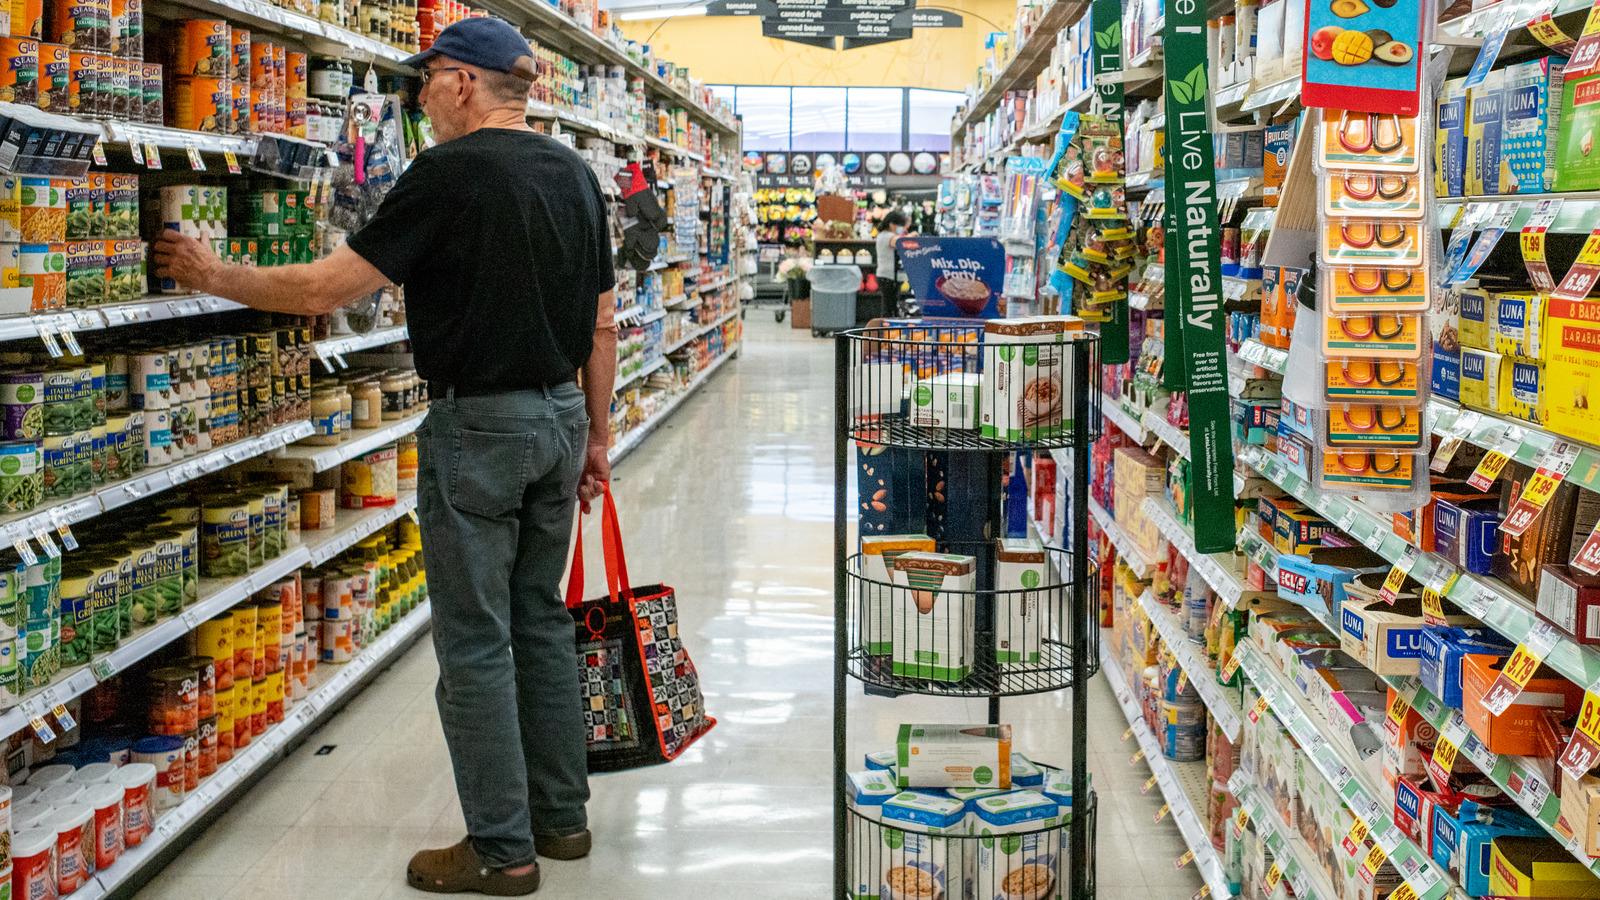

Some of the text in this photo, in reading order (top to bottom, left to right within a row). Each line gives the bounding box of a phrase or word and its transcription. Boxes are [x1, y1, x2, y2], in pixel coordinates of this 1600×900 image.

[1574, 42, 1599, 63] 6.99
[1101, 54, 1119, 95] Lie
[1475, 100, 1498, 116] LUNA
[1508, 92, 1535, 111] LUNA
[1440, 107, 1458, 122] LUNA
[1180, 112, 1218, 330] Live Naturally
[1523, 236, 1539, 252] 7.99
[931, 257, 985, 270] Mix. Dip.
[942, 270, 981, 283] Party.
[1532, 272, 1550, 288] 6.99
[1565, 273, 1591, 290] 6.99
[1462, 301, 1482, 314] LUNA
[1501, 304, 1523, 320] LUNA
[1570, 304, 1600, 320] 8 BARS
[1464, 357, 1482, 373] LUNA
[1515, 367, 1536, 385] LUNA
[1190, 386, 1226, 394] preservatives.
[1530, 477, 1553, 496] 7.99
[1438, 510, 1454, 529] LUNA
[1510, 509, 1532, 528] 6.99
[1344, 612, 1362, 634] LUNA
[1423, 634, 1437, 657] LUNA
[1507, 651, 1535, 682] 9.79
[1568, 743, 1591, 767] 8.79
[1399, 788, 1417, 813] LUNA
[1438, 818, 1454, 844] LUNA
